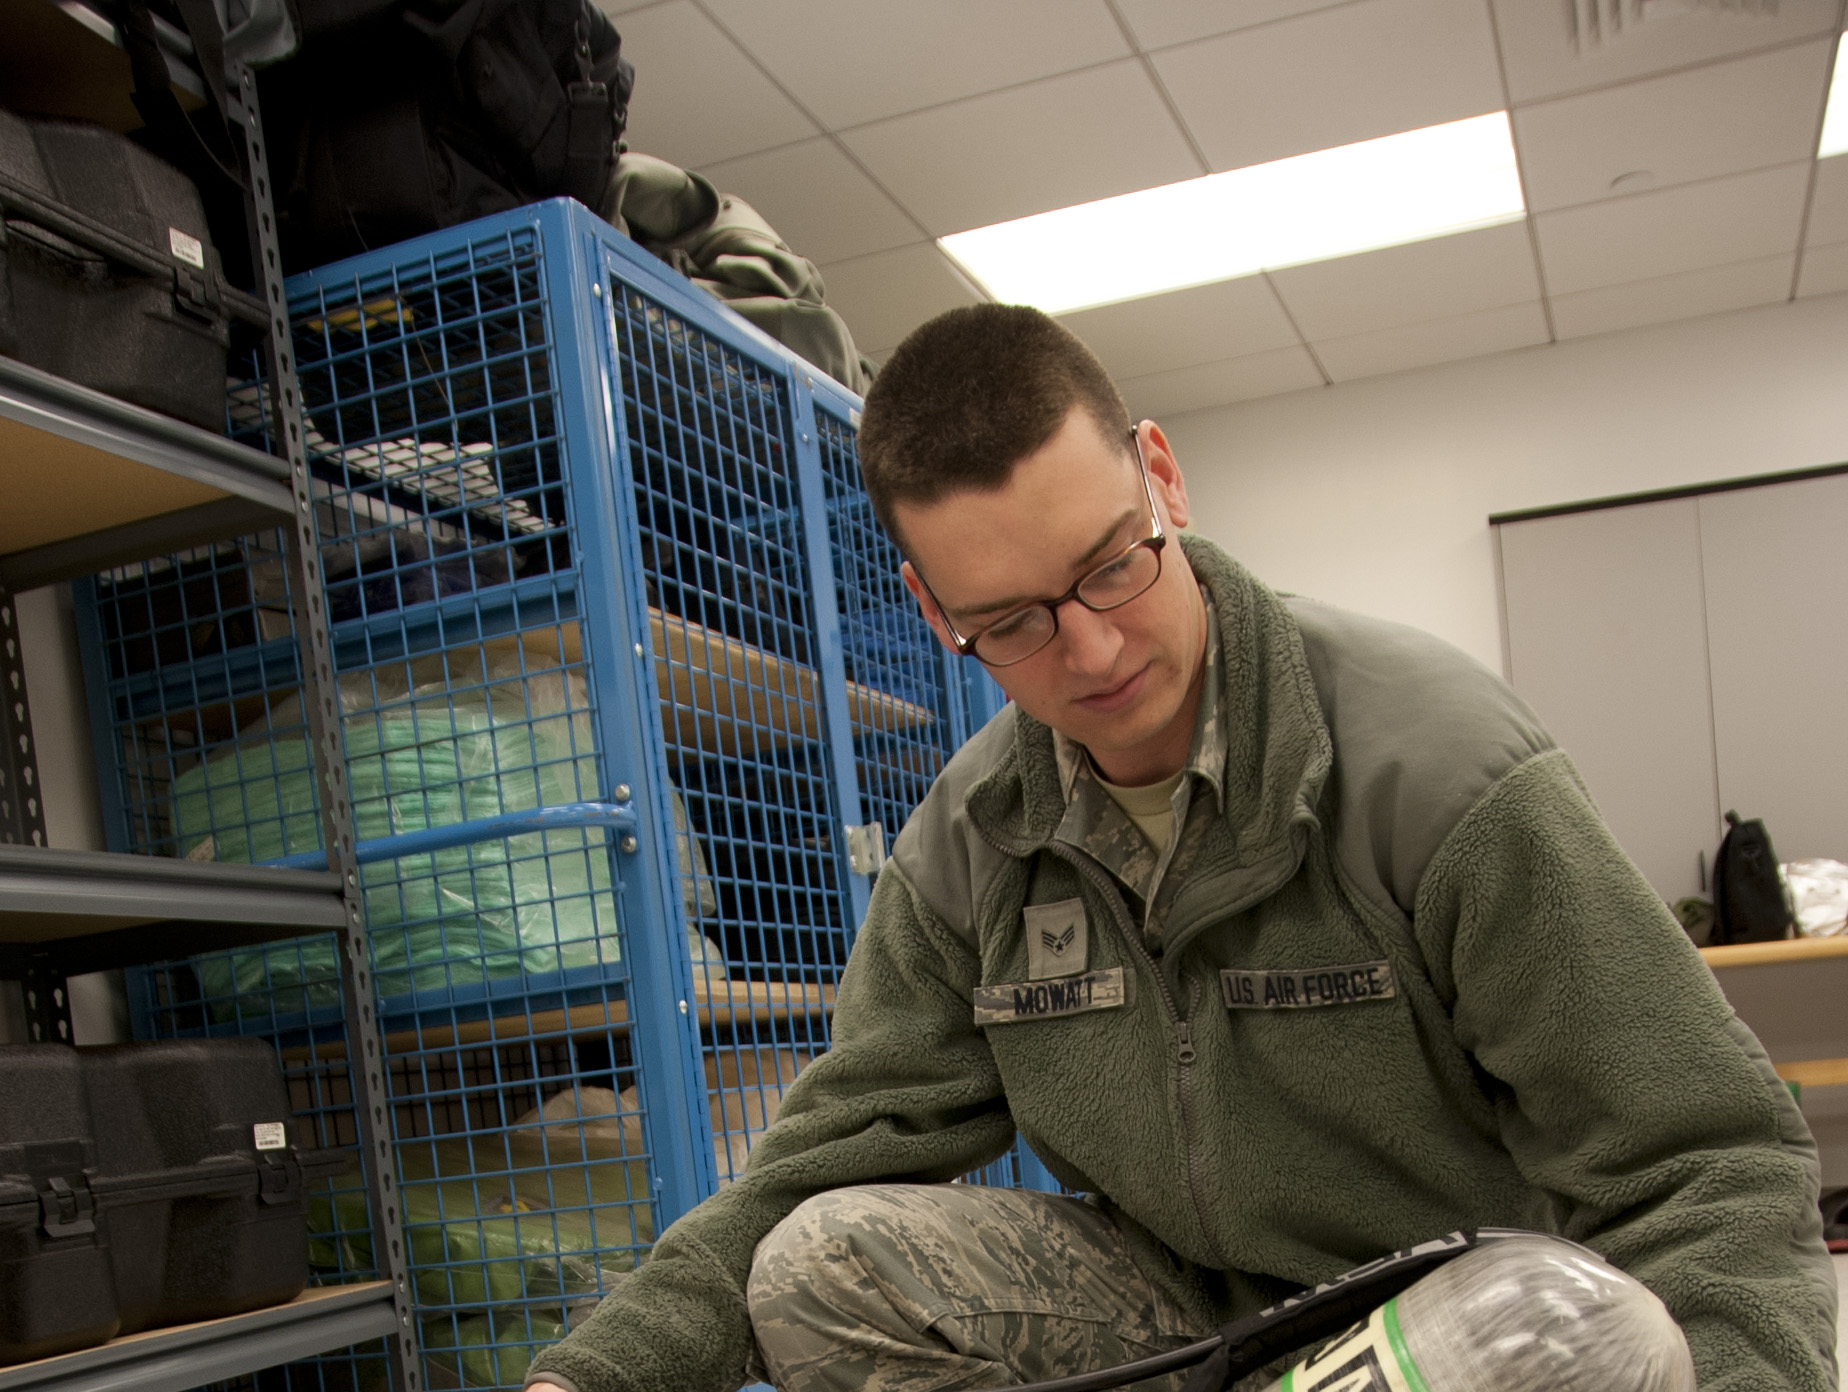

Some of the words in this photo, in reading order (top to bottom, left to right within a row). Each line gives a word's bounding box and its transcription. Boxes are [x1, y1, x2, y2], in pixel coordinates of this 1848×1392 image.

[1013, 976, 1096, 1015] MOWATT
[1265, 975, 1299, 1006] AIR
[1303, 967, 1382, 1004] FORCE
